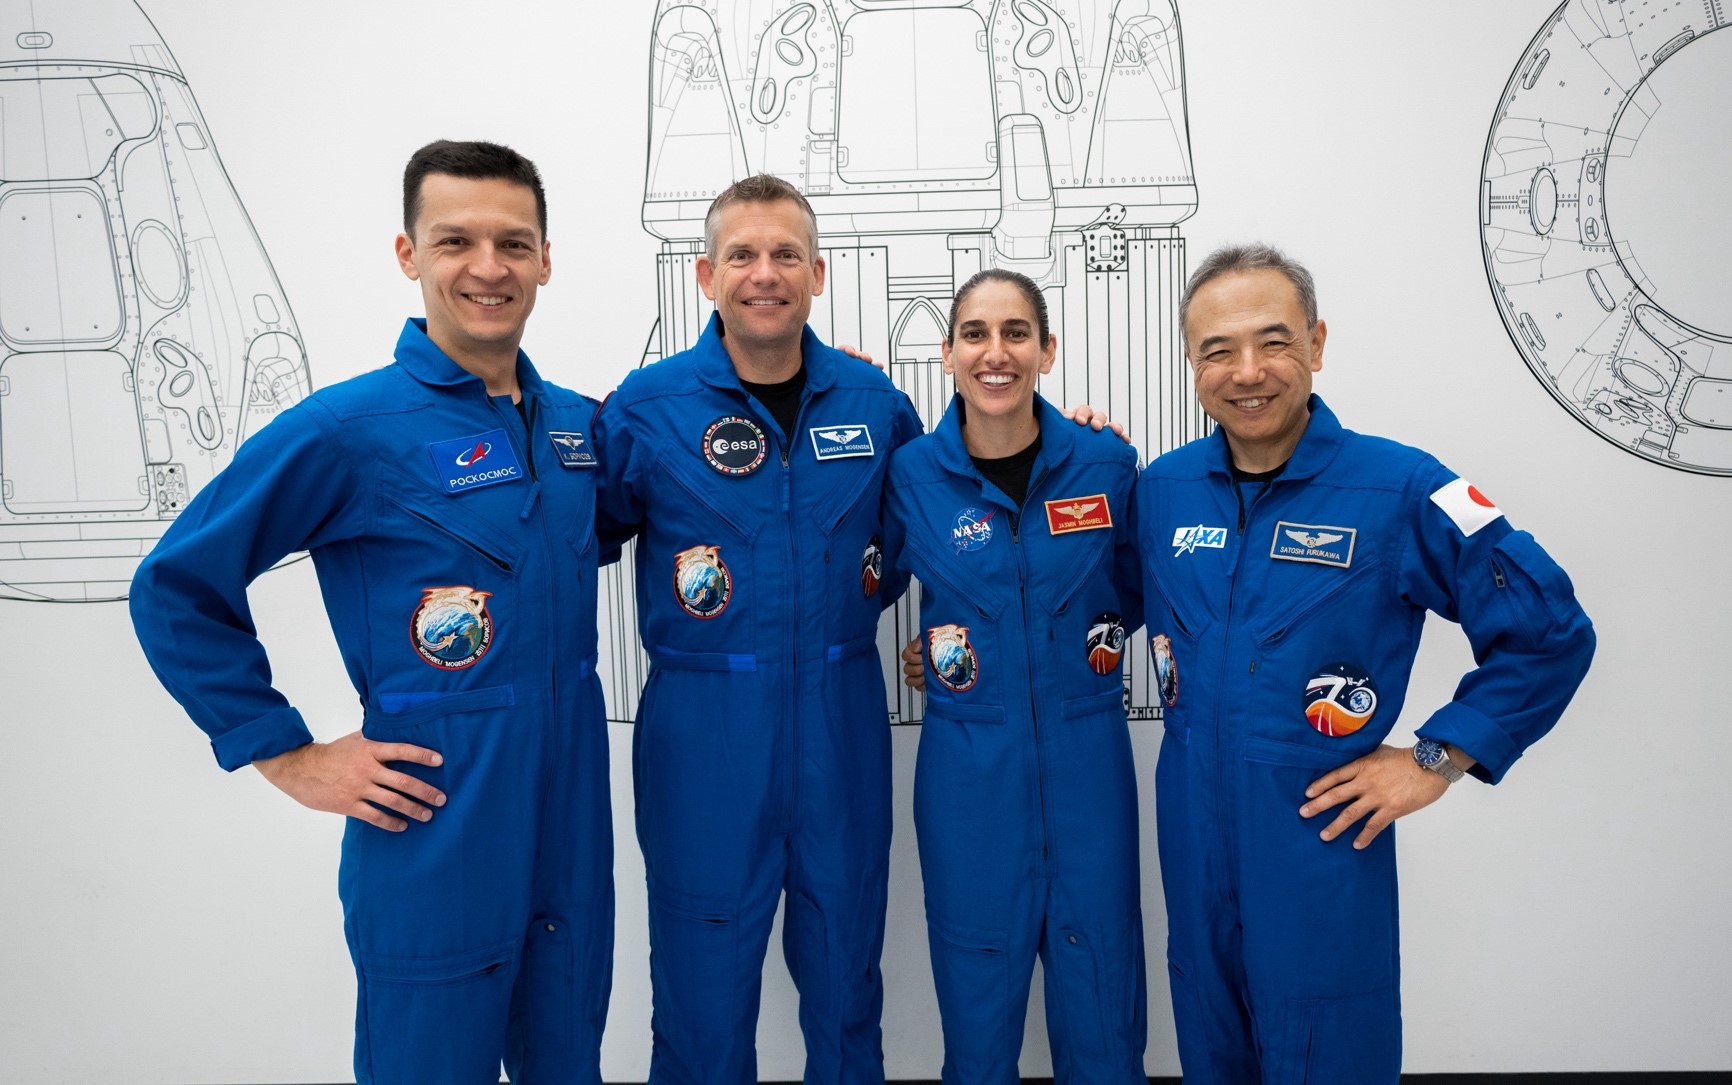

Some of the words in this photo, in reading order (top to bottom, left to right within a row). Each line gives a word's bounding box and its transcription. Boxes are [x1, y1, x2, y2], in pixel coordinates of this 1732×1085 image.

[820, 446, 843, 454] ANDREAS
[450, 466, 517, 488] РОСКОСМОС
[953, 521, 991, 539] NASA
[1058, 521, 1077, 529] JASMIN
[1078, 518, 1104, 526] MOGHBELI
[1175, 526, 1225, 552] JAXA
[1280, 546, 1305, 555] SATOSHI
[1306, 549, 1340, 560] FURUKAWA
